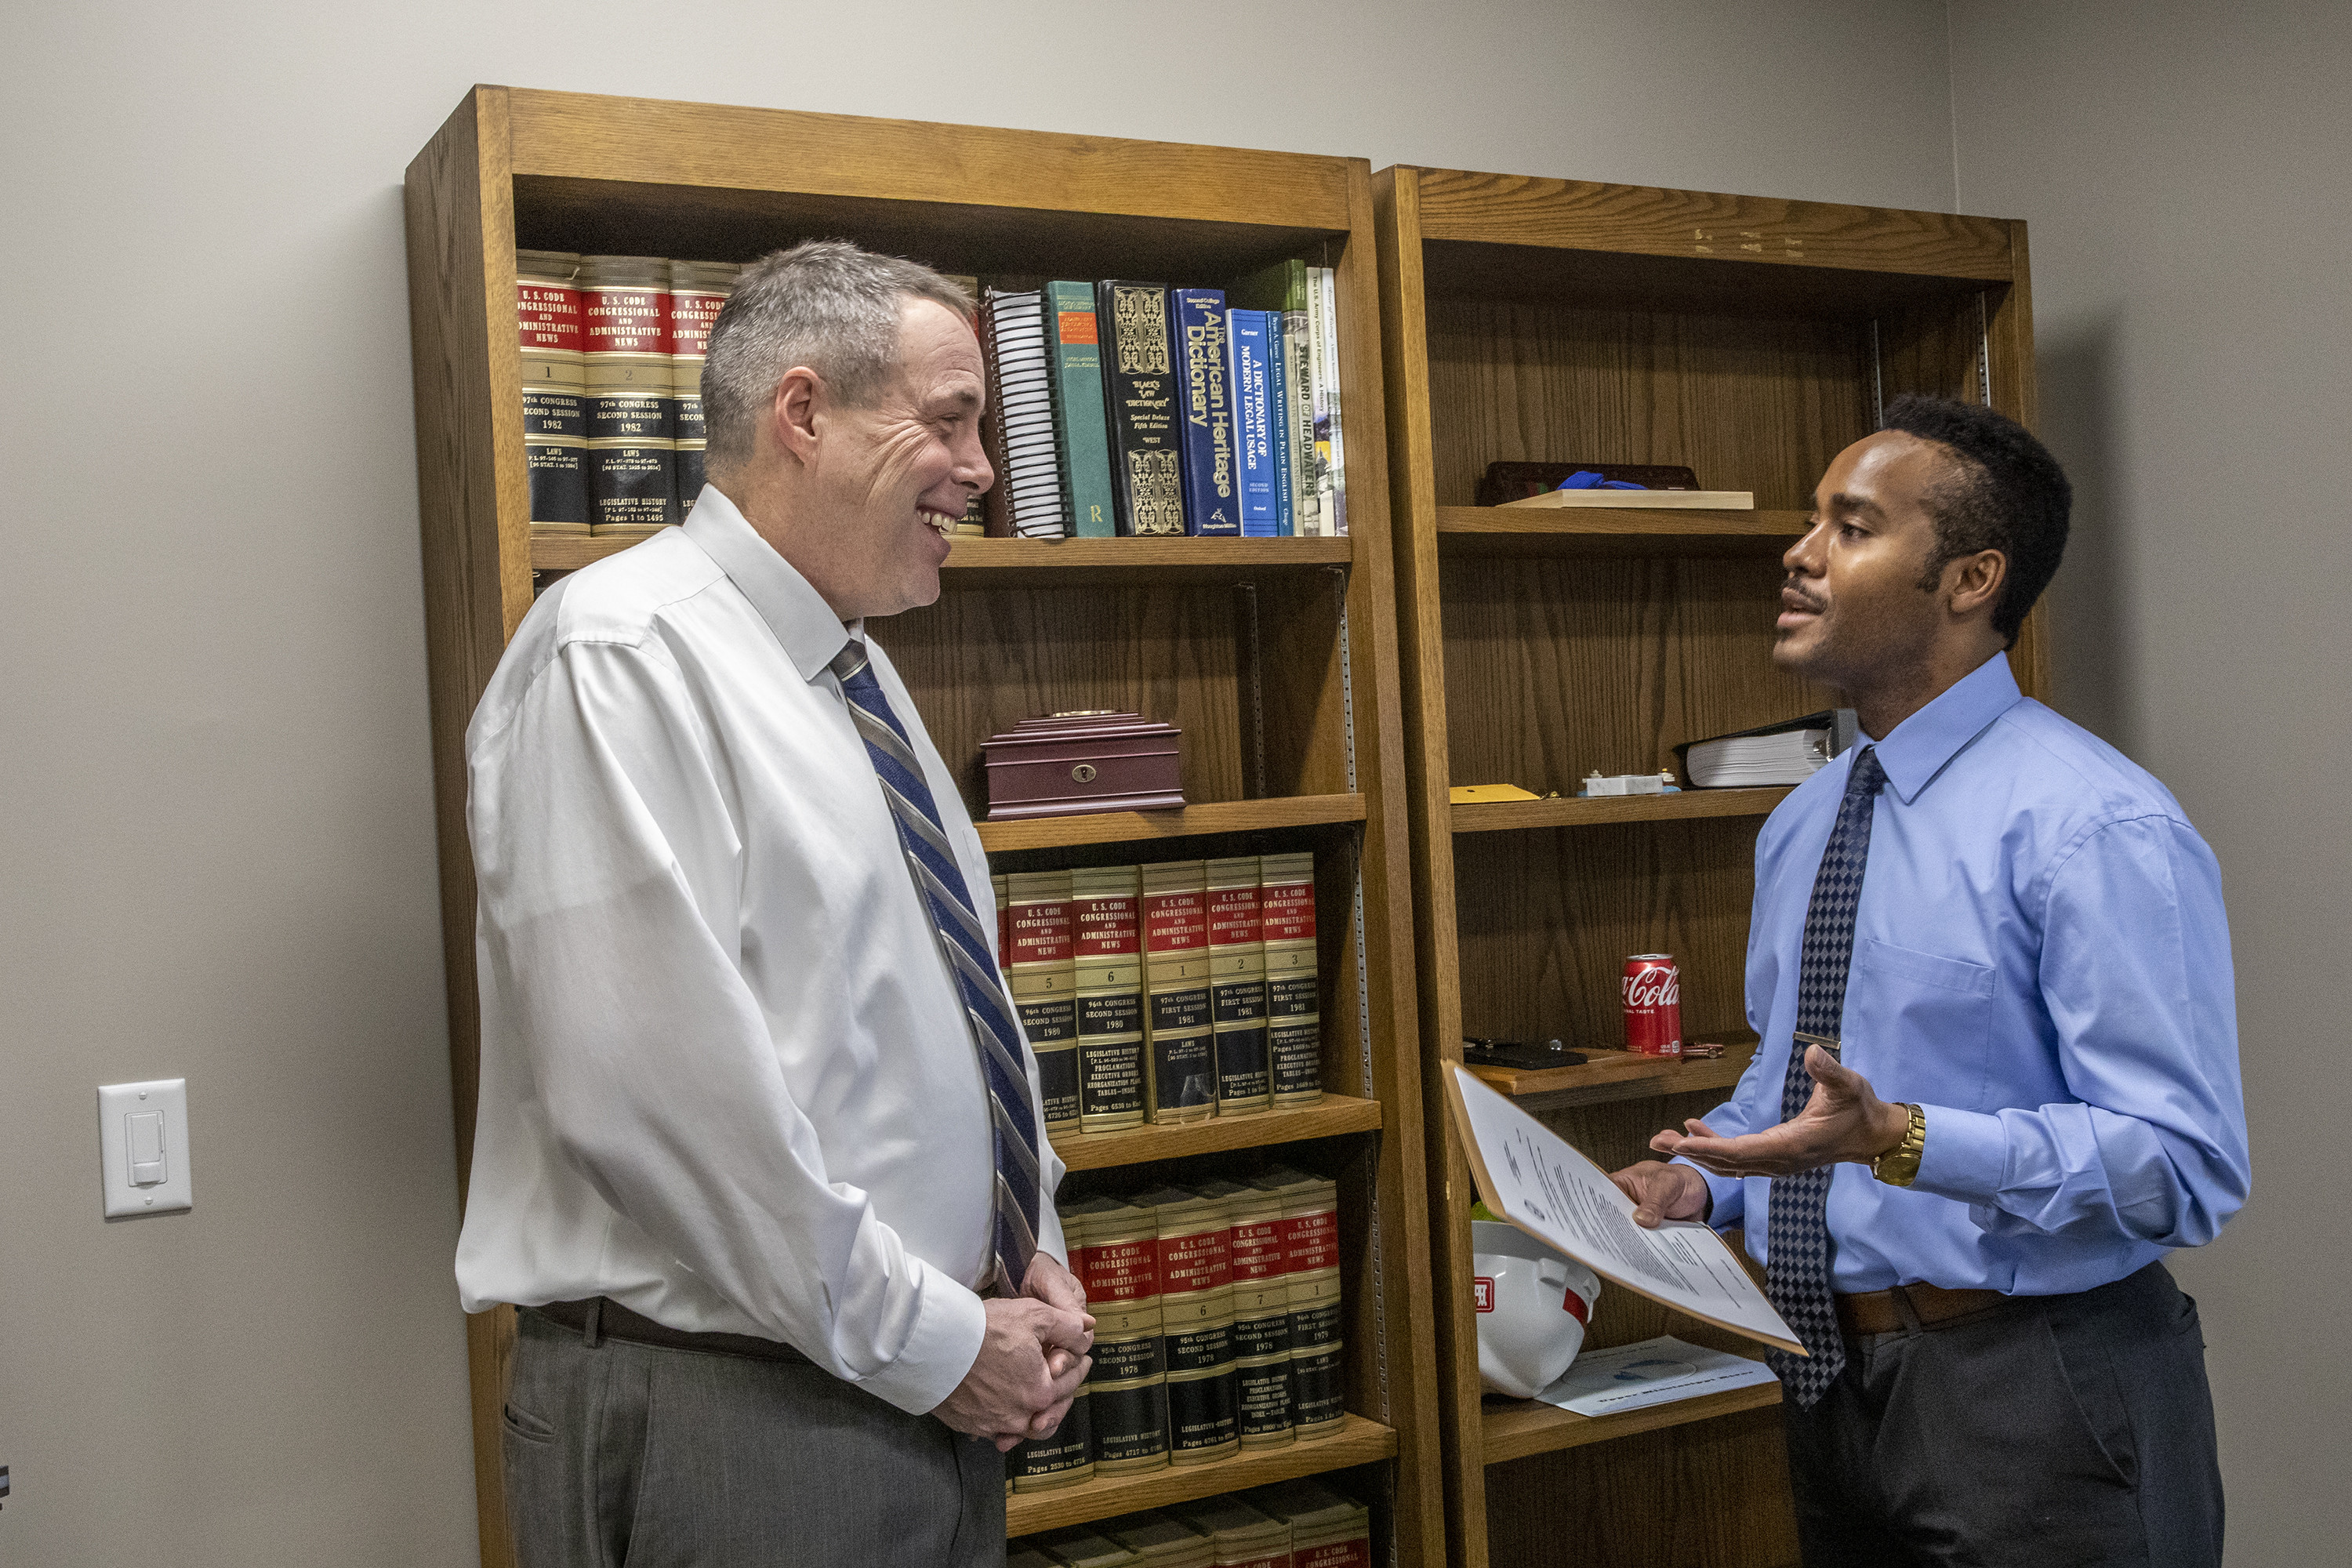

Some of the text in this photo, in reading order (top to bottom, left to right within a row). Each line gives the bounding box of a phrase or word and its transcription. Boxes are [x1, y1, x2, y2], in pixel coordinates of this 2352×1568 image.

[544, 292, 564, 302] CODE
[588, 307, 660, 317] CONGRESSIONAL
[590, 327, 661, 336] ADMINISTRATIVE
[536, 333, 558, 343] NEWS
[546, 367, 551, 377] 1
[626, 369, 633, 380] 2
[1187, 326, 1208, 427] Dictionary
[1138, 390, 1155, 399] LAW
[540, 397, 577, 406] CONGRESS
[1126, 397, 1170, 409] DICTIONARY
[1204, 310, 1231, 498] American Heritage
[552, 408, 579, 417] SESSION
[1241, 346, 1256, 470] MODERN LEGAL USAGE
[1253, 360, 1267, 457] A DICTIONARY OF
[543, 420, 562, 429] 1982
[1299, 346, 1315, 496] STEWARD OF HEADWATERS
[1091, 505, 1102, 522] R
[1080, 911, 1135, 922] CONGRESSIONAL
[1151, 907, 1203, 918] CONGRESSIONAL
[1017, 917, 1069, 928] CONGRESSIONAL
[1081, 930, 1135, 940] ADMINISTRATIVE
[1152, 924, 1203, 936] ADMINISTRATIVE
[1018, 935, 1070, 946] ADMINISTRATIVE
[1102, 941, 1120, 949] NEWS
[1172, 936, 1190, 945] NEWS
[1037, 947, 1056, 956] NEWS
[1238, 959, 1243, 969] 2
[1292, 954, 1298, 964] 3
[1180, 966, 1185, 975] 1
[1108, 971, 1114, 982] 6
[1046, 978, 1052, 989] 5
[1176, 993, 1207, 1003] CONGRESS
[1042, 1005, 1071, 1014] CONGRESS
[1184, 1003, 1207, 1011] SESSION
[1238, 1007, 1253, 1016] 1981
[1106, 1020, 1123, 1029] 1980
[1178, 1015, 1195, 1024] 1981
[1044, 1028, 1060, 1036] 1980
[1232, 1236, 1279, 1248] CONGRESSIONAL
[1122, 1247, 1140, 1257] CODE
[1169, 1245, 1225, 1261] CONGRESSIONAL
[1090, 1254, 1151, 1269] CONGRESSIONAL
[1233, 1252, 1281, 1266] ADMINISTRATIVE
[1308, 1256, 1324, 1265] NEWS
[1171, 1262, 1226, 1279] ADMINISTRATIVE
[1250, 1265, 1266, 1274] NEWS
[1092, 1272, 1152, 1287] ADMINISTRATIVE
[1114, 1287, 1134, 1295] NEWS
[1257, 1294, 1263, 1305] 7
[1200, 1305, 1207, 1316] 6
[1122, 1317, 1128, 1327] 5
[1254, 1319, 1285, 1330] CONGRESS
[1196, 1330, 1225, 1342] CONGRESS
[1235, 1327, 1288, 1341] SECOND SESSION
[1118, 1342, 1152, 1352] CONGRESS
[1178, 1340, 1228, 1355] SECOND SESSION
[1256, 1341, 1272, 1351] 1978
[1130, 1352, 1154, 1362] SESSION
[1198, 1354, 1214, 1363] 1978
[1120, 1366, 1138, 1374] 1978
[1027, 1443, 1084, 1458] LEGISLATIVE HISTORY
